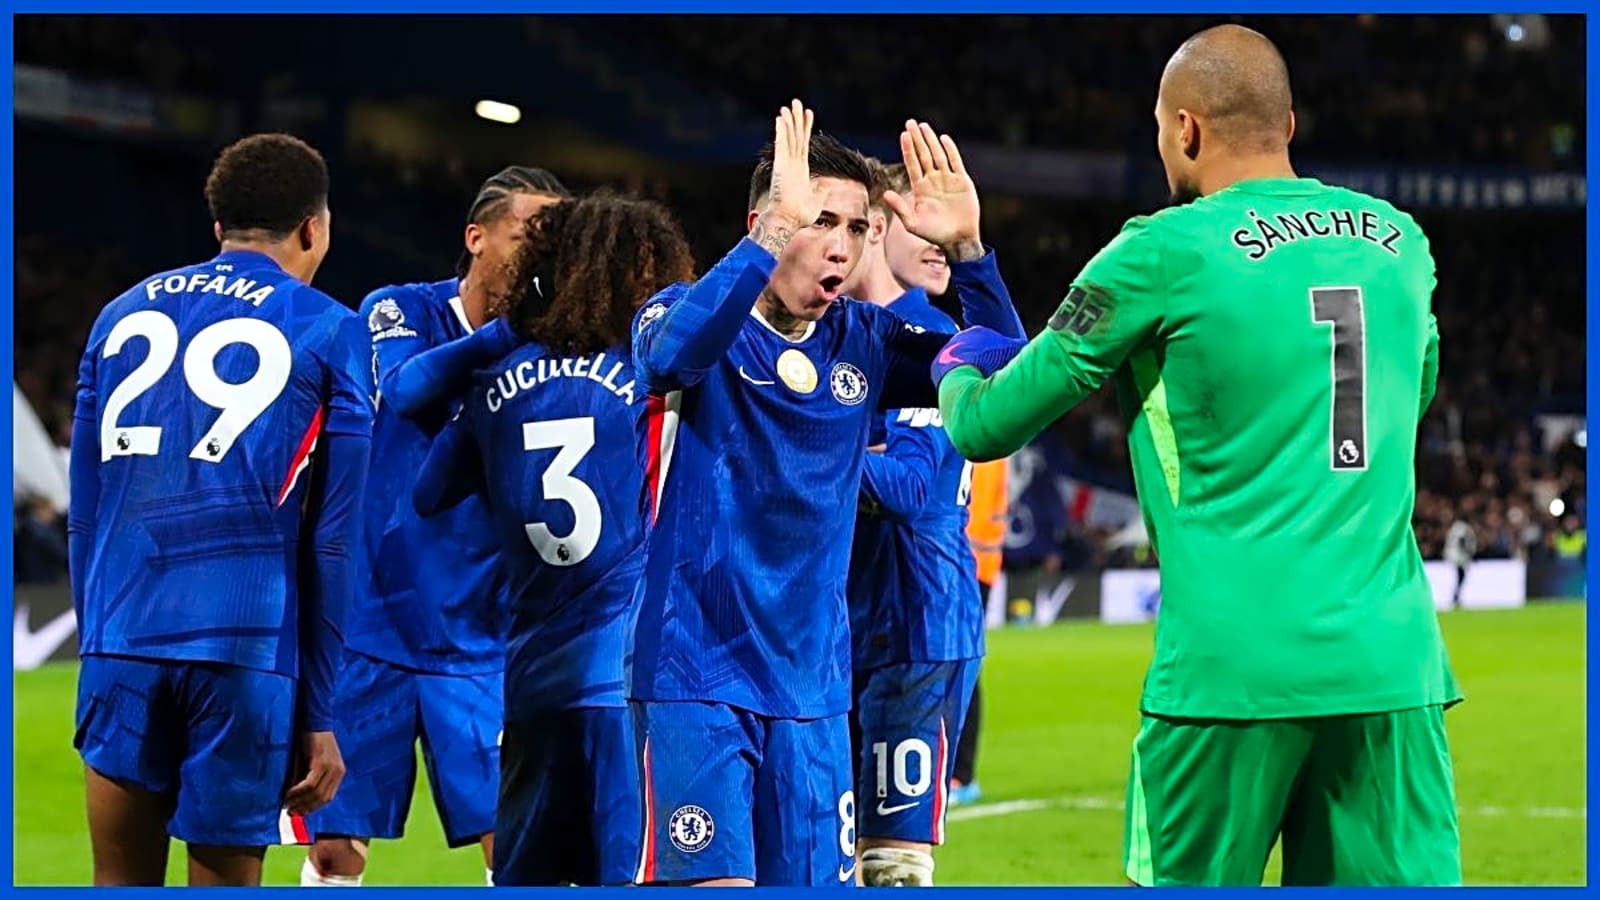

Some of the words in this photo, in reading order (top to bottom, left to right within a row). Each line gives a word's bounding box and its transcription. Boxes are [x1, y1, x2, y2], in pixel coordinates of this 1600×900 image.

[1233, 210, 1402, 259] SÁNCHEZ
[146, 274, 275, 307] FOFANA
[100, 310, 292, 463] 29
[1309, 285, 1368, 471] 1
[522, 416, 602, 567] 3
[872, 738, 932, 798] 10
[838, 790, 856, 857] 8
